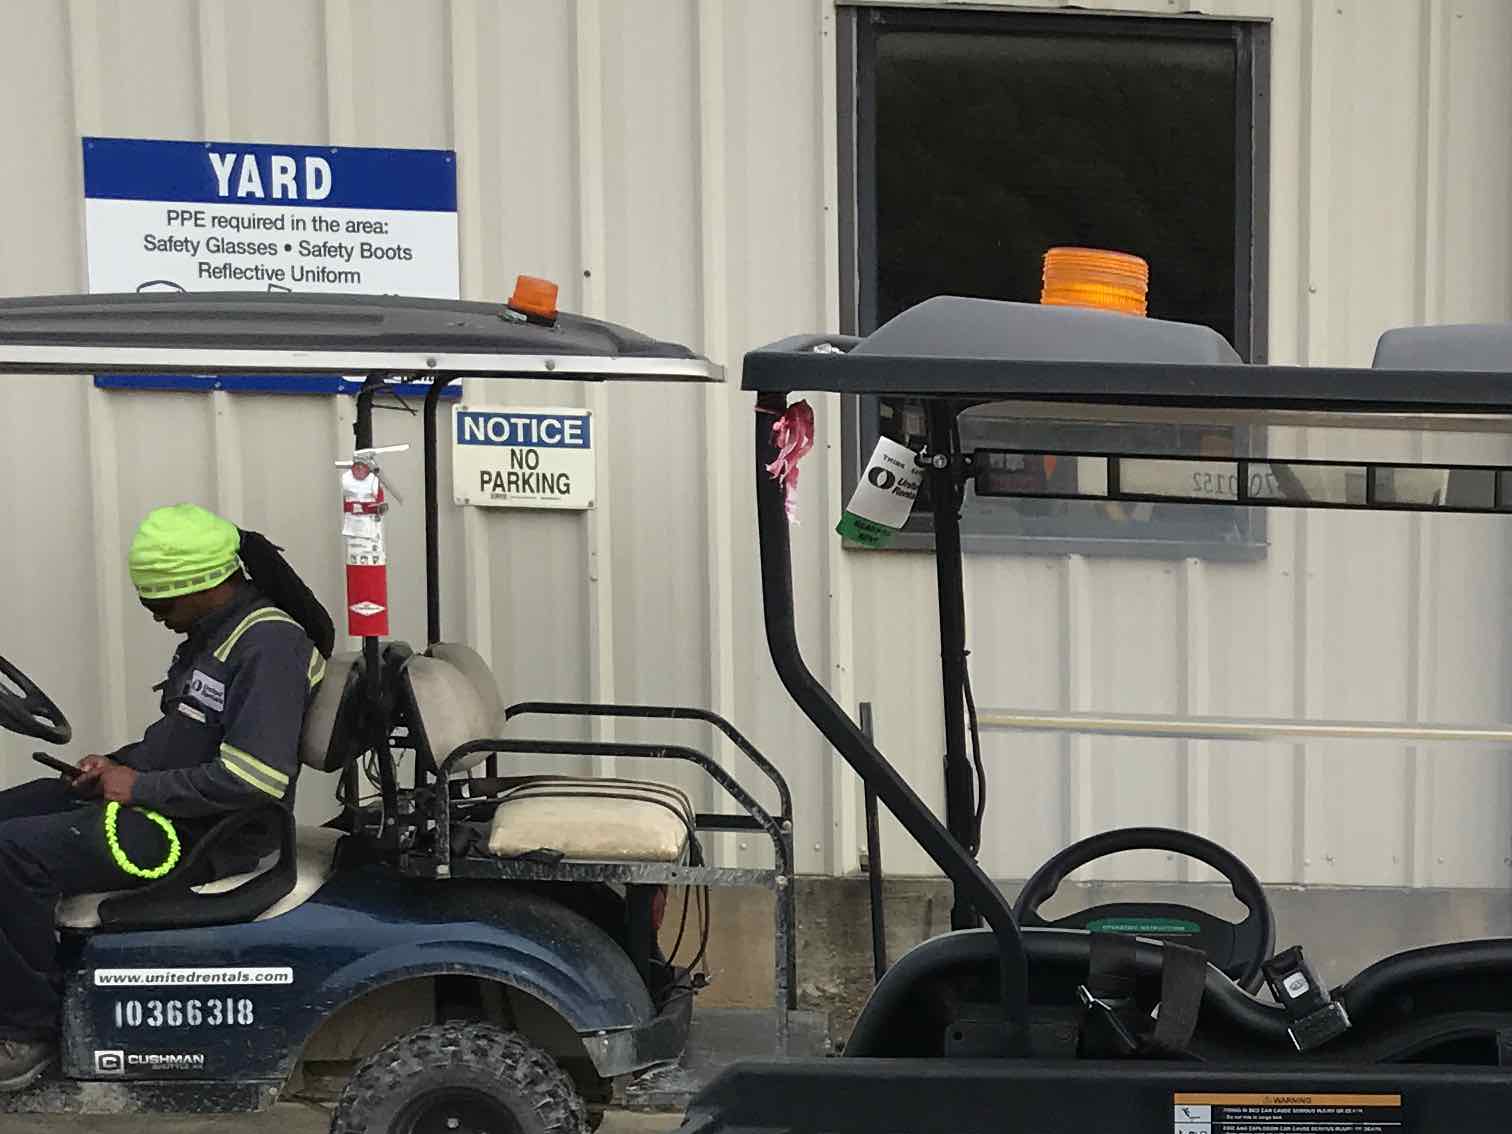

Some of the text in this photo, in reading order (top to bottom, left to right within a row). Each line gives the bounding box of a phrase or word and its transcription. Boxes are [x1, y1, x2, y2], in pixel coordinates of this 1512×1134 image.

[208, 152, 333, 200] YARD
[166, 209, 389, 236] PPE required in the area:
[143, 233, 413, 262] Safety Glasses Safety Boots
[198, 261, 361, 284] Reflective Uniform
[463, 416, 584, 444] NOTICE
[510, 448, 540, 470] NO
[479, 470, 571, 494] PARKING
[98, 971, 289, 984] www.unitedrentals.com
[114, 998, 255, 1029] 10366318
[127, 1054, 205, 1065] CUSHMAN
[1272, 1096, 1312, 1105] WARNING
